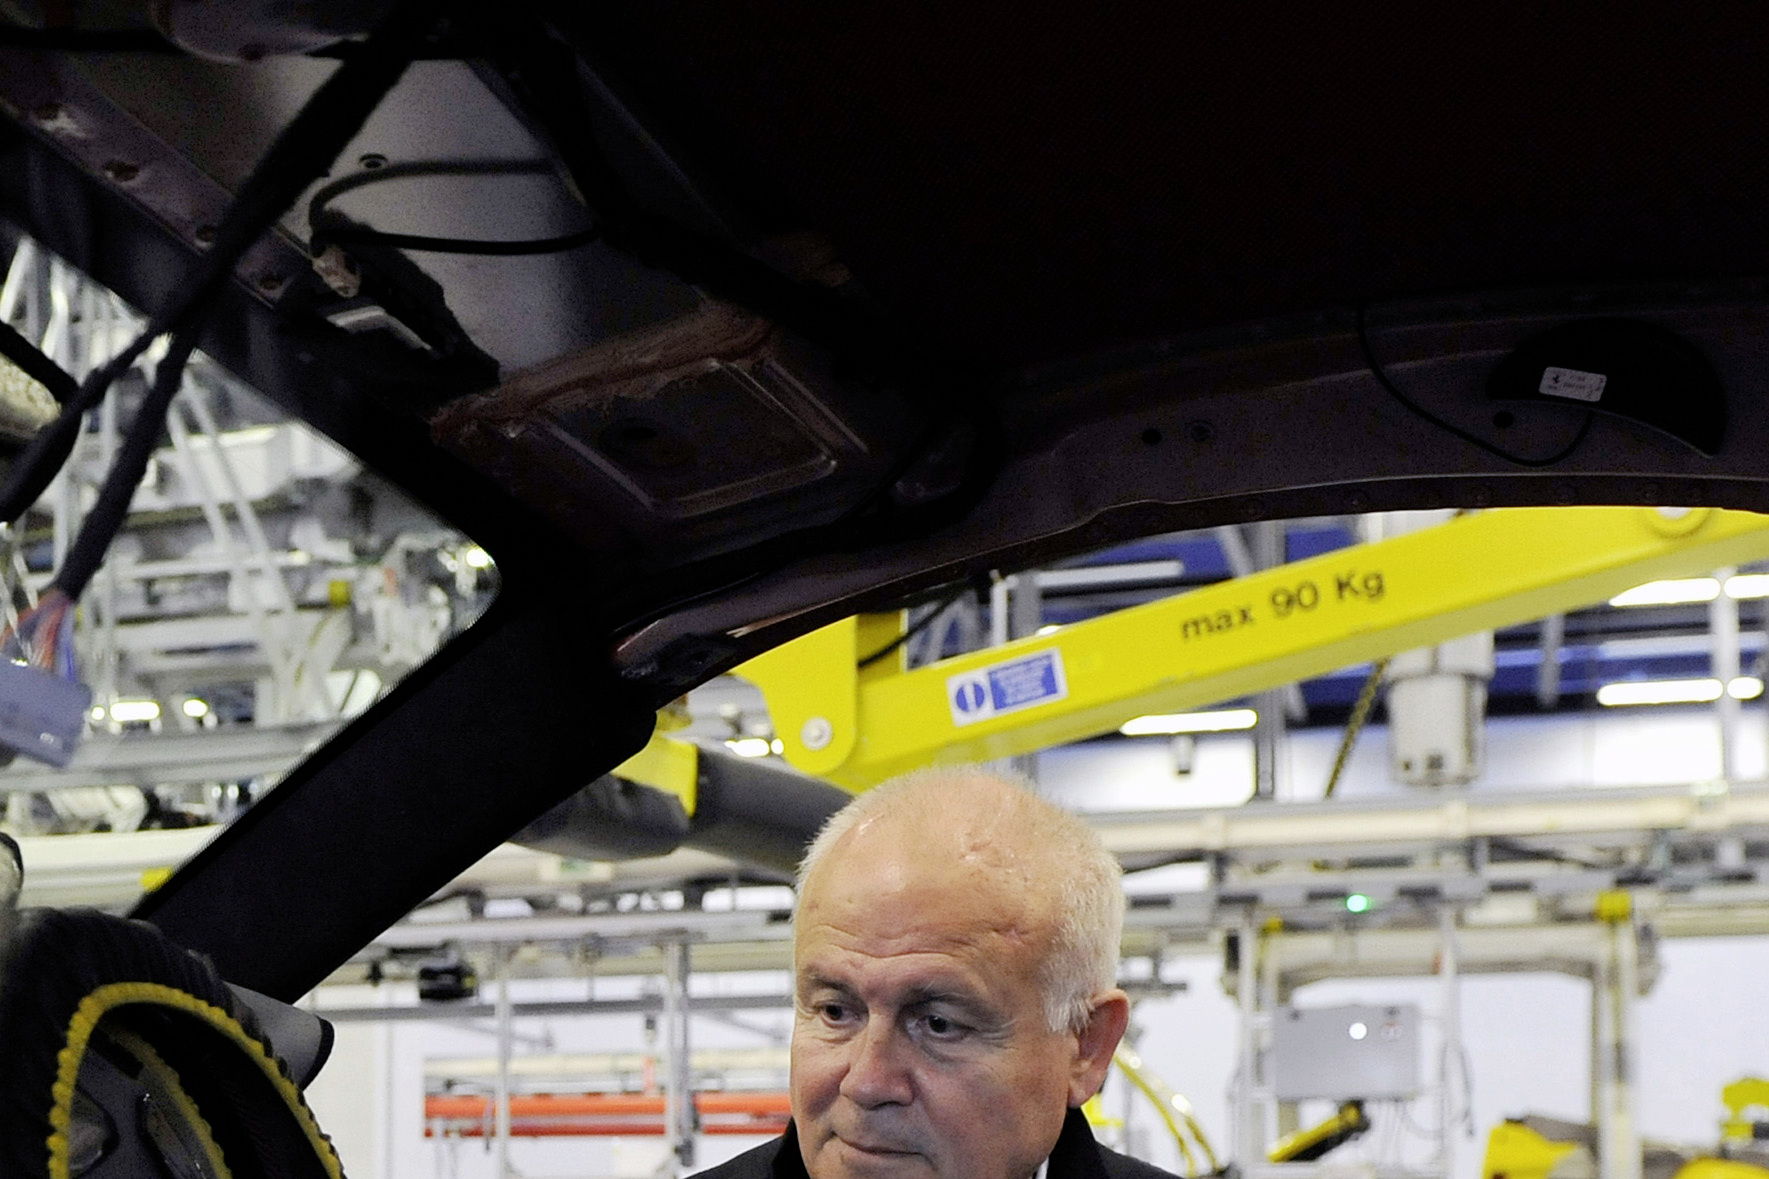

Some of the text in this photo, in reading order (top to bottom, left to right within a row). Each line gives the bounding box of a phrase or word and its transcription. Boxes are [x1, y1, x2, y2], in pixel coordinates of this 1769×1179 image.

[1182, 571, 1385, 640] max 90 Kg
